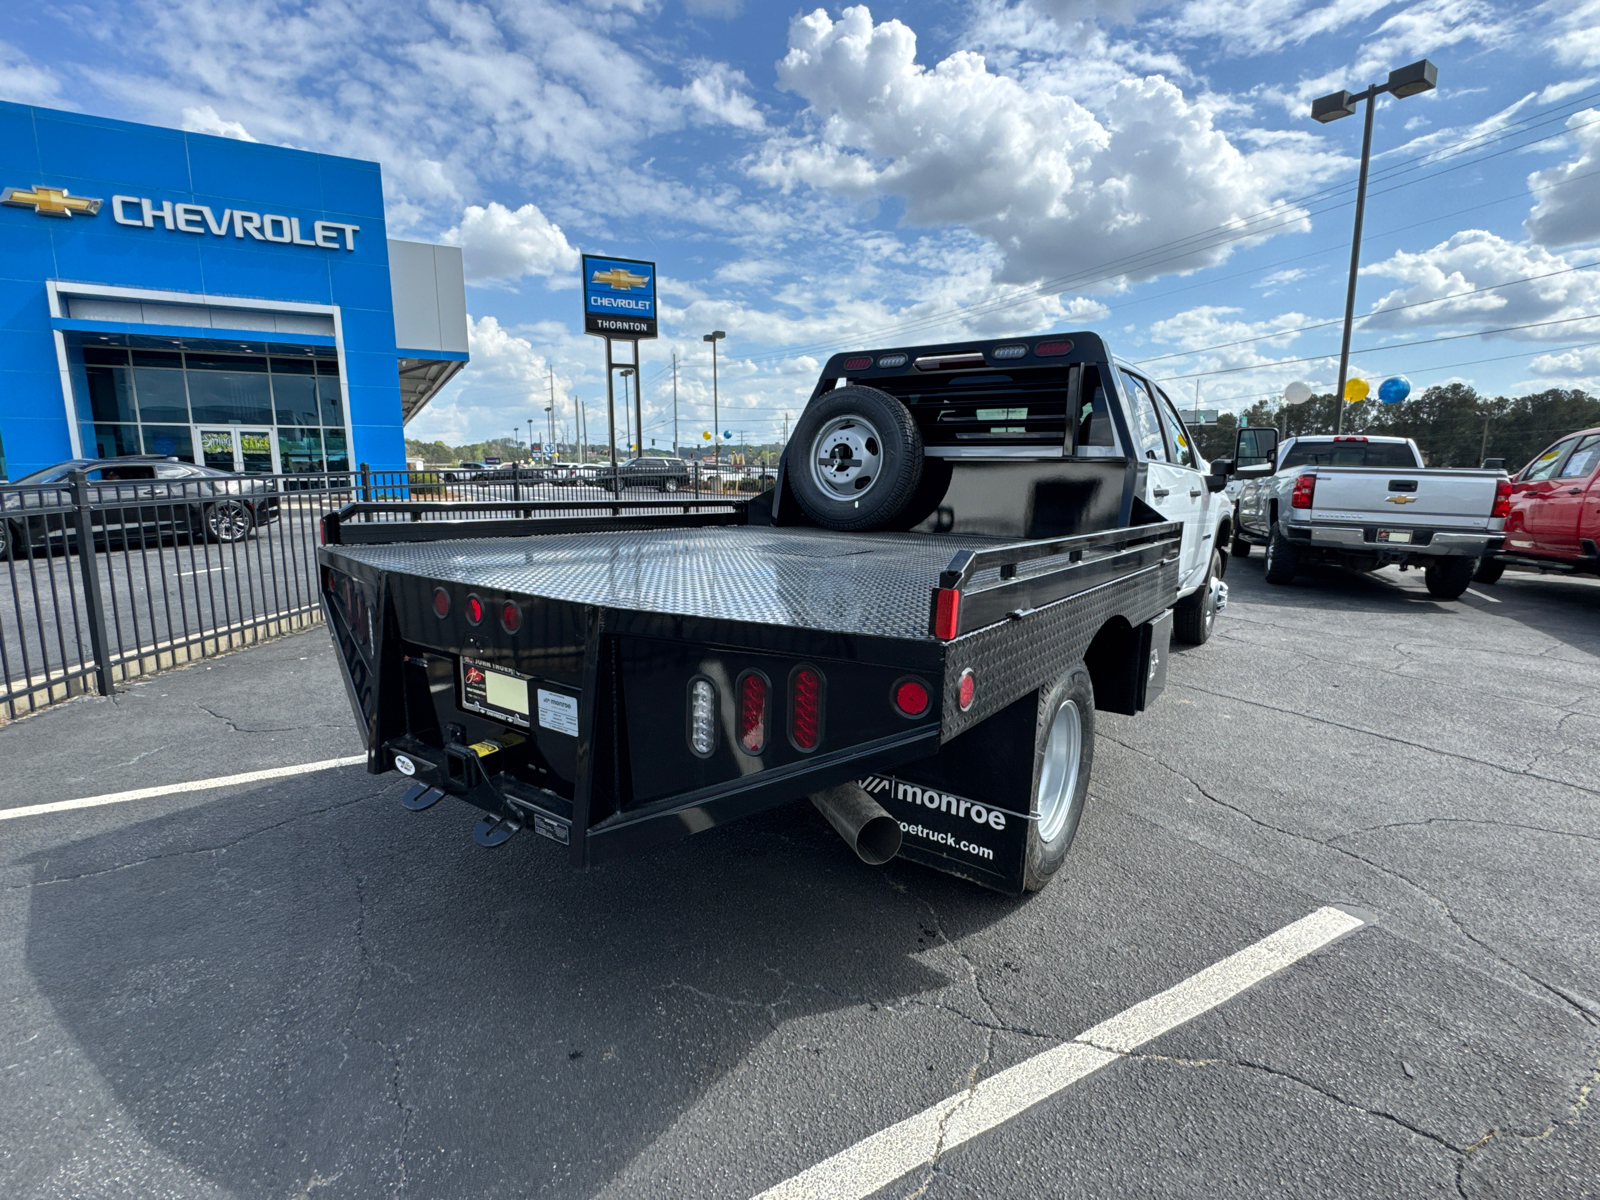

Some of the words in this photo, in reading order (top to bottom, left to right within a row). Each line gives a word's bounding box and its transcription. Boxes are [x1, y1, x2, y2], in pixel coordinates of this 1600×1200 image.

[112, 194, 360, 251] CHEVROLET
[590, 296, 651, 310] CHEVROLET
[597, 319, 647, 331] THORNTON
[550, 699, 572, 709] monroe
[897, 782, 1007, 830] monroe
